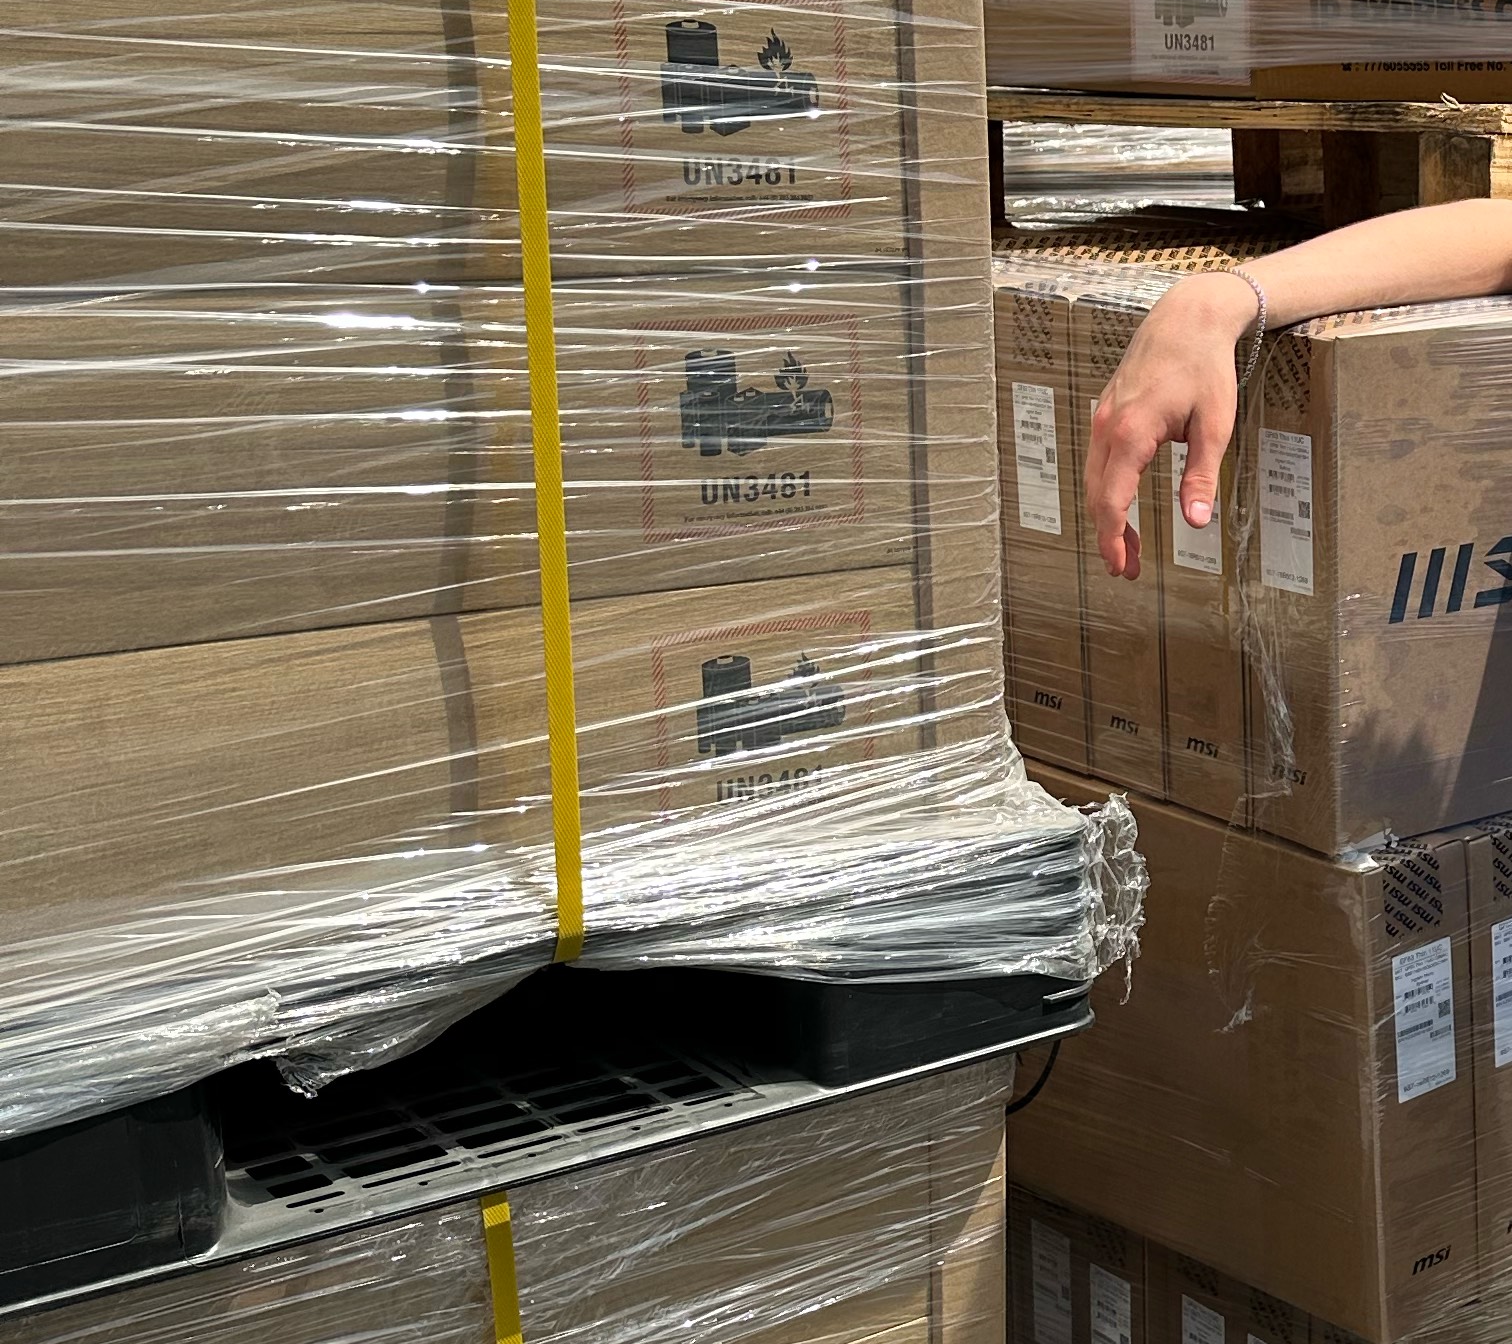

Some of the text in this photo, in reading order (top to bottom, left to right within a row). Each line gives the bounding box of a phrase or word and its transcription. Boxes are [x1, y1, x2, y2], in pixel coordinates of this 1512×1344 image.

[1163, 32, 1216, 52] UN3481
[1434, 59, 1454, 72] Toll
[1457, 59, 1484, 72] Free
[1486, 59, 1506, 71] No.
[682, 156, 797, 187] UN3481
[701, 471, 811, 505] UN3481
[1034, 687, 1062, 711] msi
[1109, 712, 1140, 736] msi
[1186, 736, 1220, 759] msi
[1411, 1245, 1452, 1276] msi
